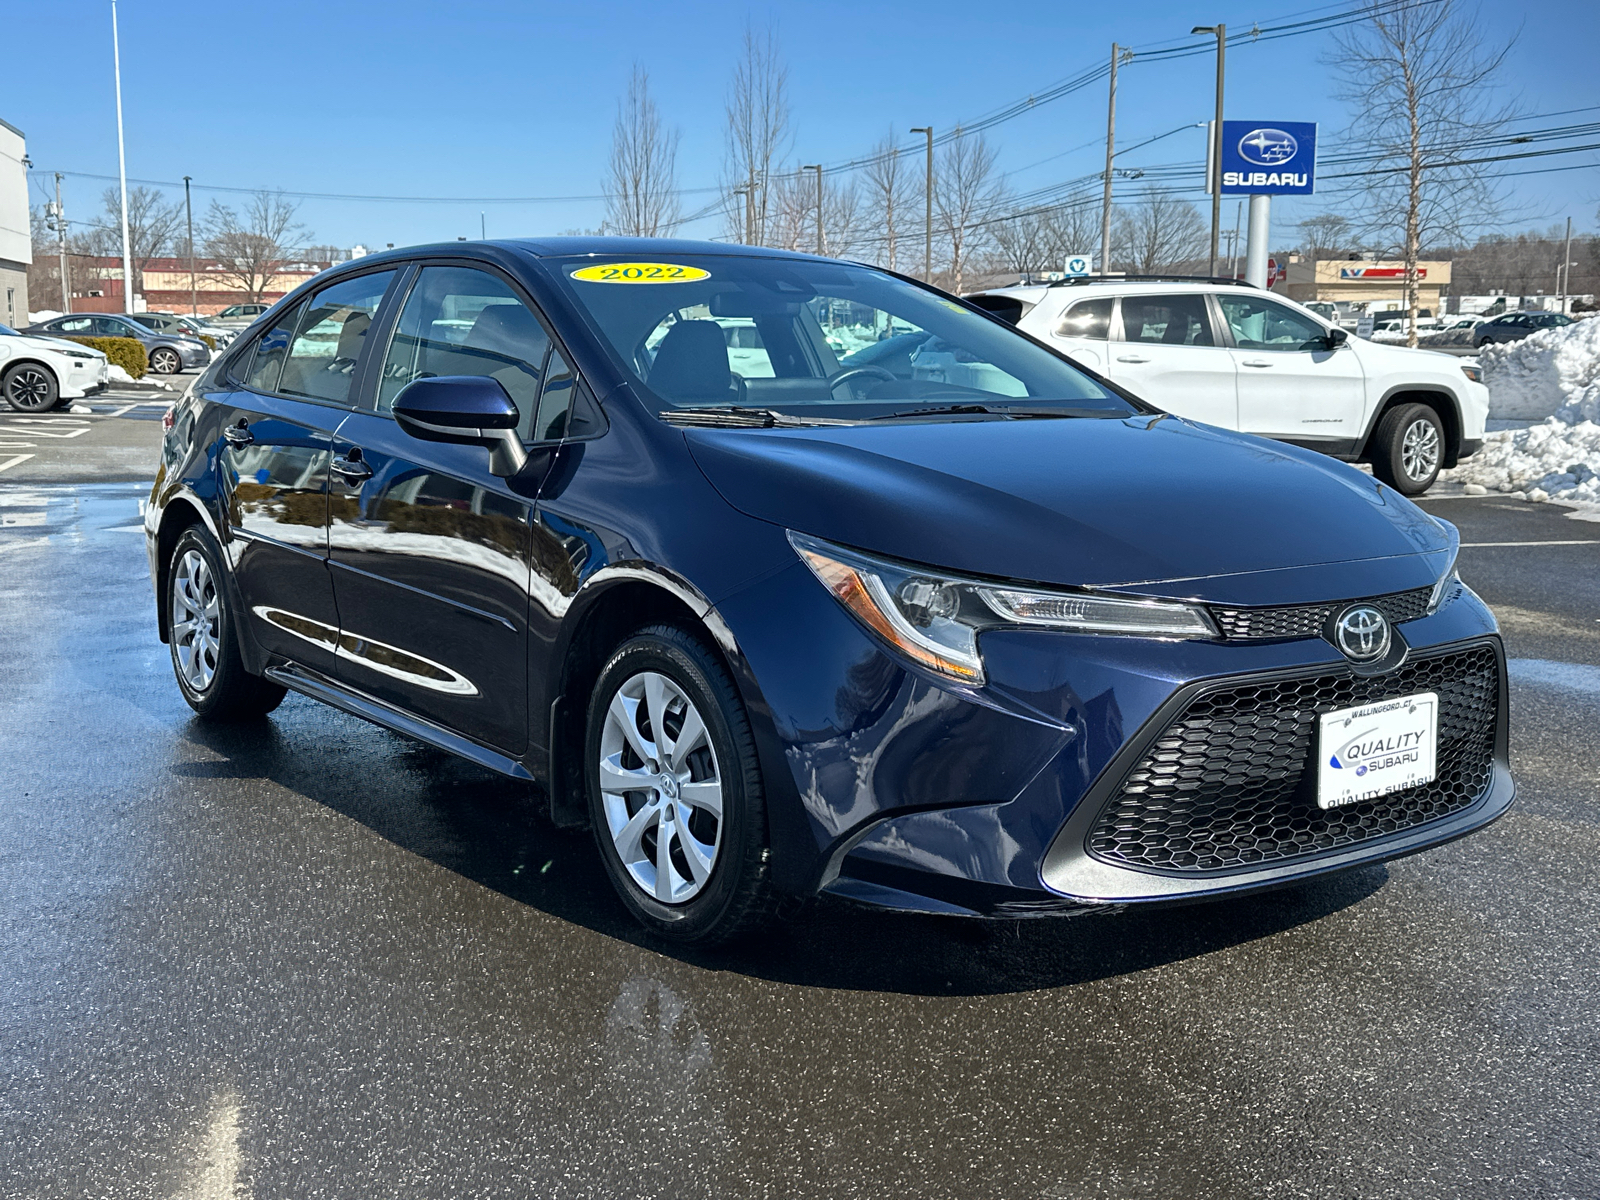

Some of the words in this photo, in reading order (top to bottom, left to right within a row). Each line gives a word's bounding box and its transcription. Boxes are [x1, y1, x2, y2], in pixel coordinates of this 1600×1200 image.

[1223, 172, 1307, 187] SUBARU
[600, 267, 686, 279] 2022
[1403, 699, 1412, 708] CT
[1347, 729, 1425, 760] QUALITY
[1369, 752, 1418, 772] SUBARU
[1327, 788, 1380, 808] QUALITY
[1385, 775, 1432, 794] SUBARU
